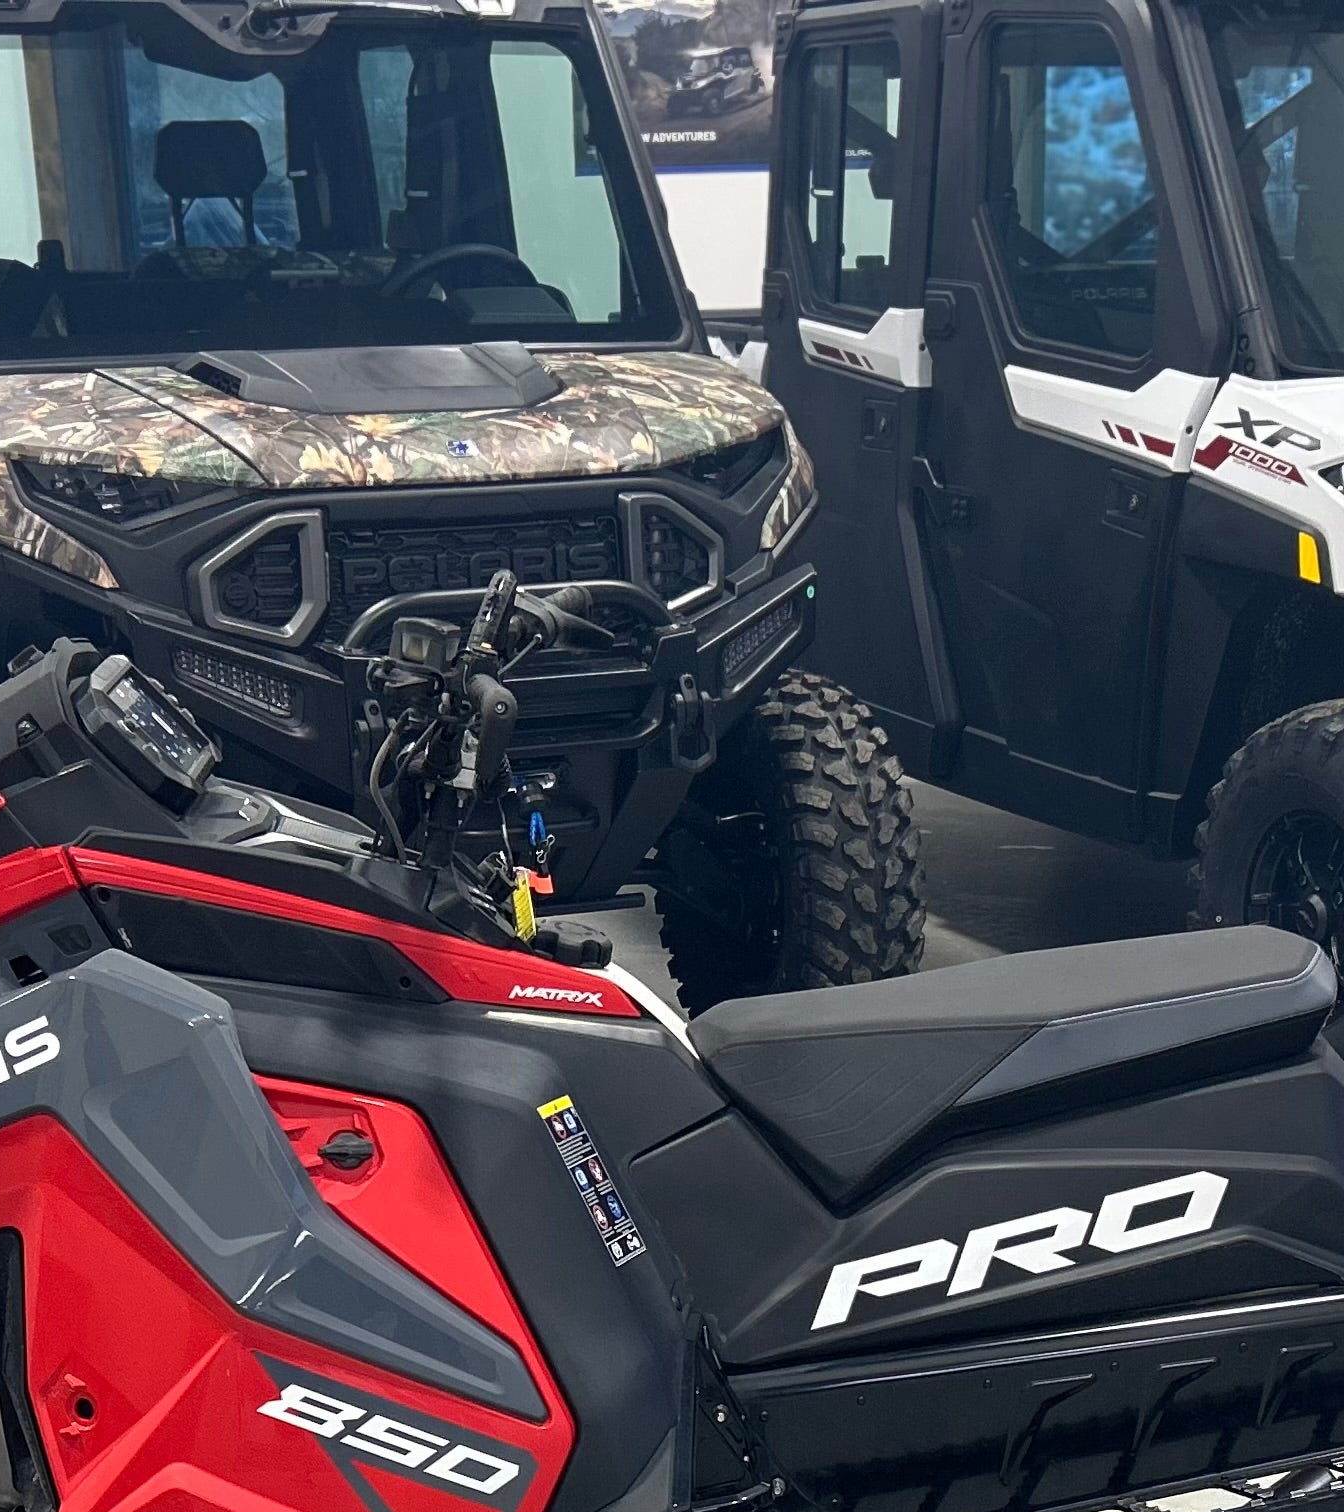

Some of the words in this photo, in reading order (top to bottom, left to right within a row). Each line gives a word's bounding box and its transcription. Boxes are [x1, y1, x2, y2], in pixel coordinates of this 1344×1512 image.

[652, 130, 717, 143] ADVENTURES
[1213, 406, 1321, 452] XP
[1227, 442, 1293, 476] 1000
[341, 542, 610, 595] POLARIS
[508, 984, 605, 1008] MATRYX
[810, 1170, 1229, 1331] PRO
[256, 1384, 520, 1495] 850
